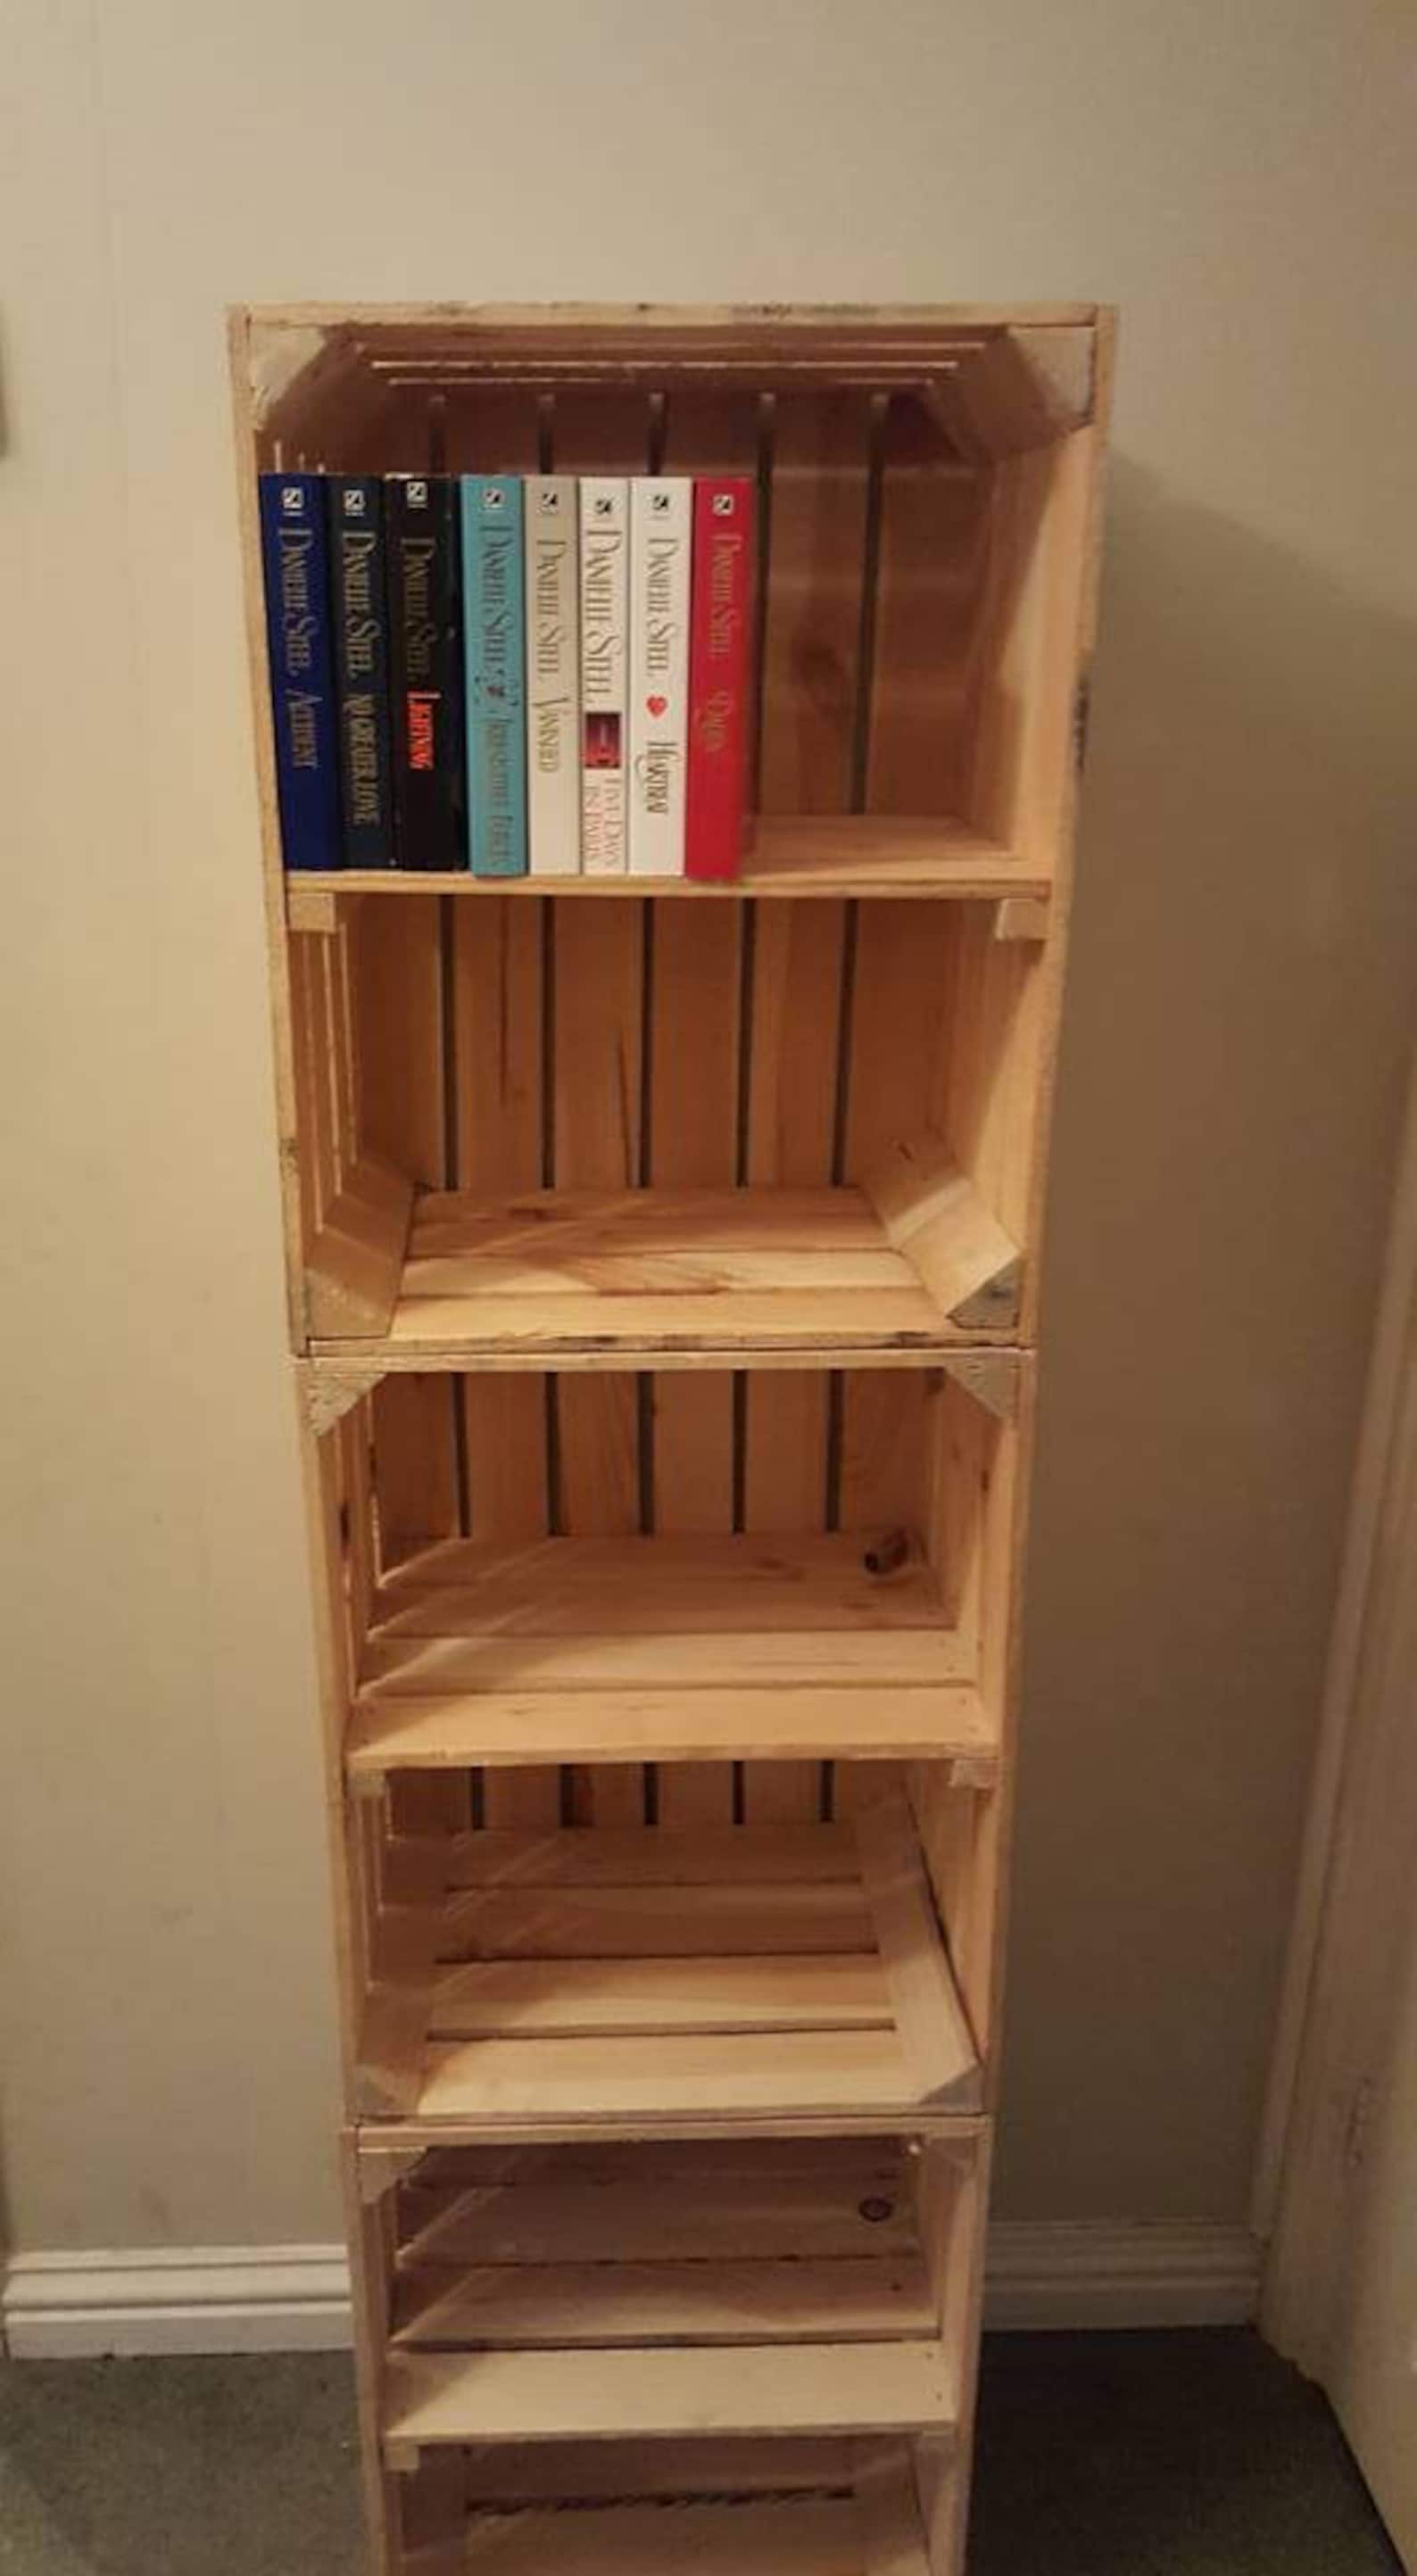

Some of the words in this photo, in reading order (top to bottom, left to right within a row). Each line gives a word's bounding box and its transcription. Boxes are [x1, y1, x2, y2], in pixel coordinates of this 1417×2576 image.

[278, 528, 312, 609] DANIELLE
[343, 532, 376, 610] DANIELLE
[481, 526, 514, 607] DANIELLE
[536, 541, 568, 616] DANIELLE
[585, 530, 623, 621] DANIELLE
[646, 539, 679, 613] DANIELLE
[284, 612, 319, 676] STEEL
[345, 613, 381, 683] STEEL
[537, 621, 567, 683] STEEL
[585, 629, 622, 703] STEEL
[646, 617, 676, 676] STEEL
[407, 691, 442, 771] LIGHTNING
